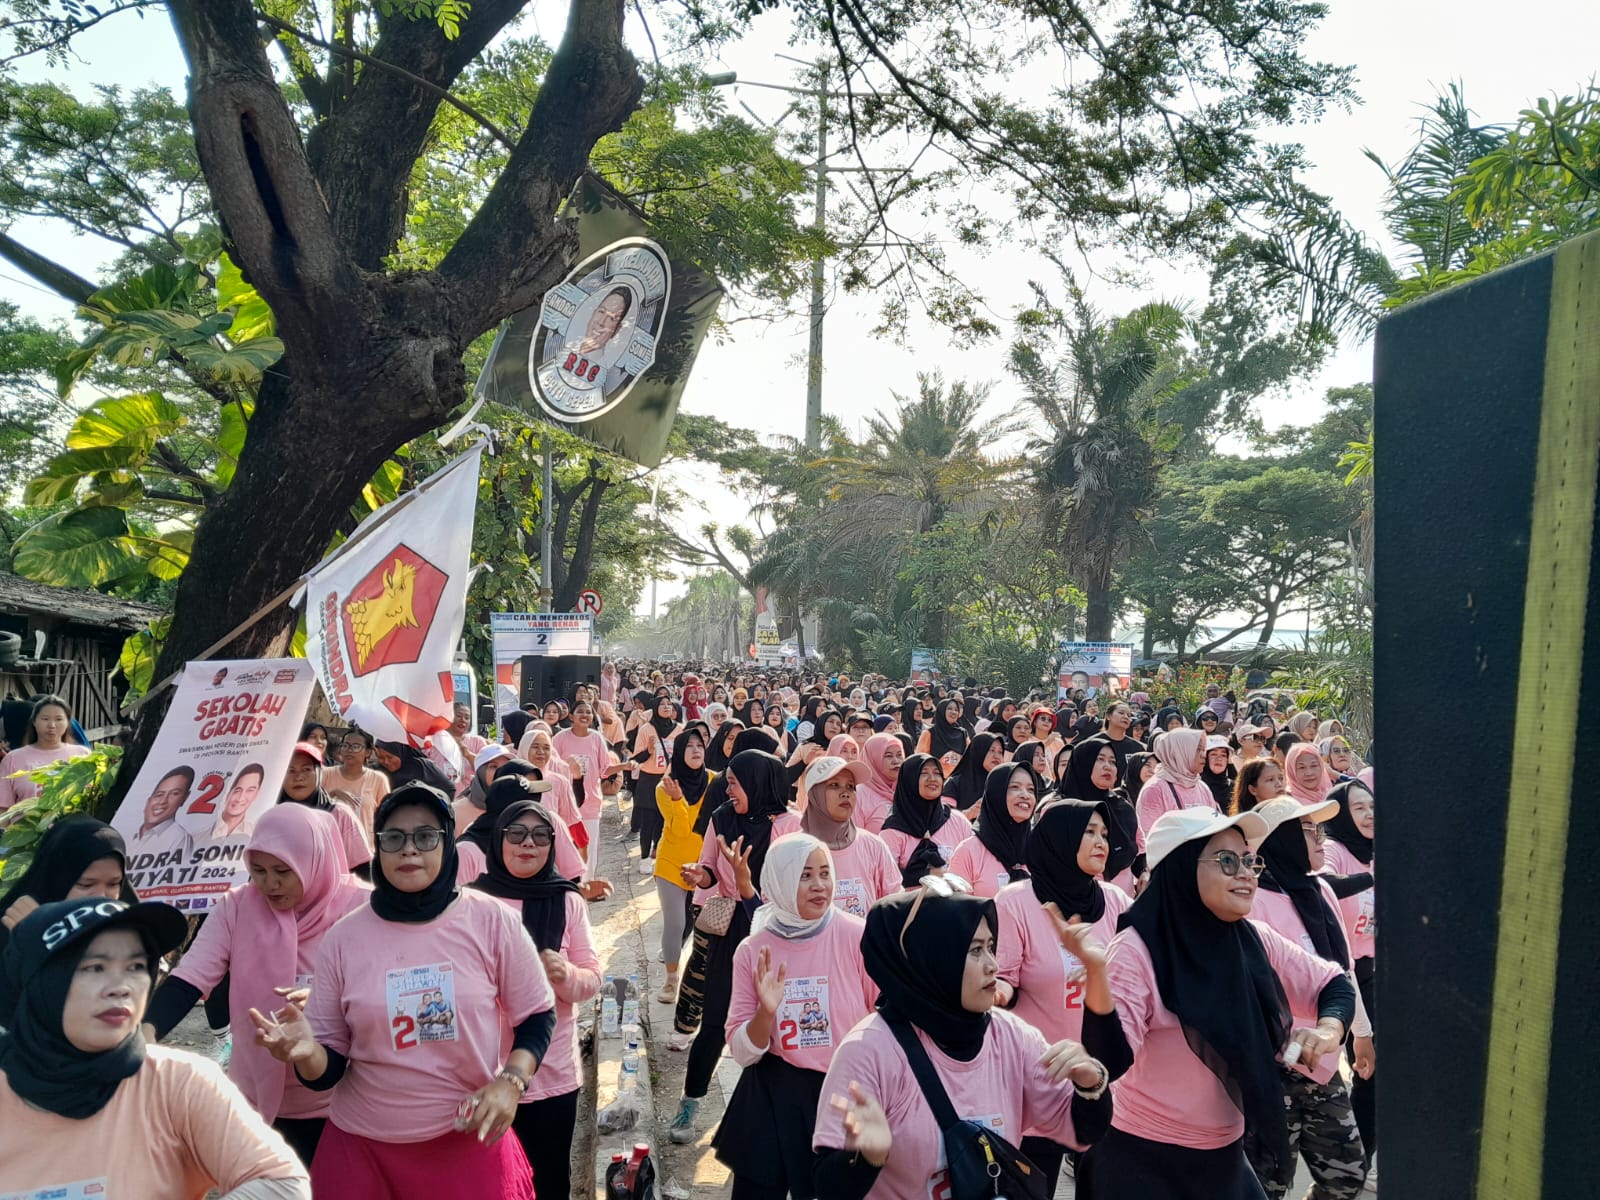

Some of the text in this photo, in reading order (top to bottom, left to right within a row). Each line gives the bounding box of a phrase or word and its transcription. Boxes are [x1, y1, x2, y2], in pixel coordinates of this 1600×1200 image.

[562, 352, 601, 382] RBC
[537, 633, 548, 645] 2
[1089, 655, 1097, 664] 2
[193, 692, 287, 721] SEKOLAH
[199, 715, 267, 741] GRATIS
[657, 755, 665, 768] 2
[186, 773, 225, 815] 2
[126, 844, 245, 871] NDRA SONI
[127, 866, 236, 888] MYATI 2024
[1354, 914, 1368, 936] 2
[1065, 980, 1082, 1009] 2
[392, 1015, 417, 1050] 2
[780, 1019, 799, 1051] 2
